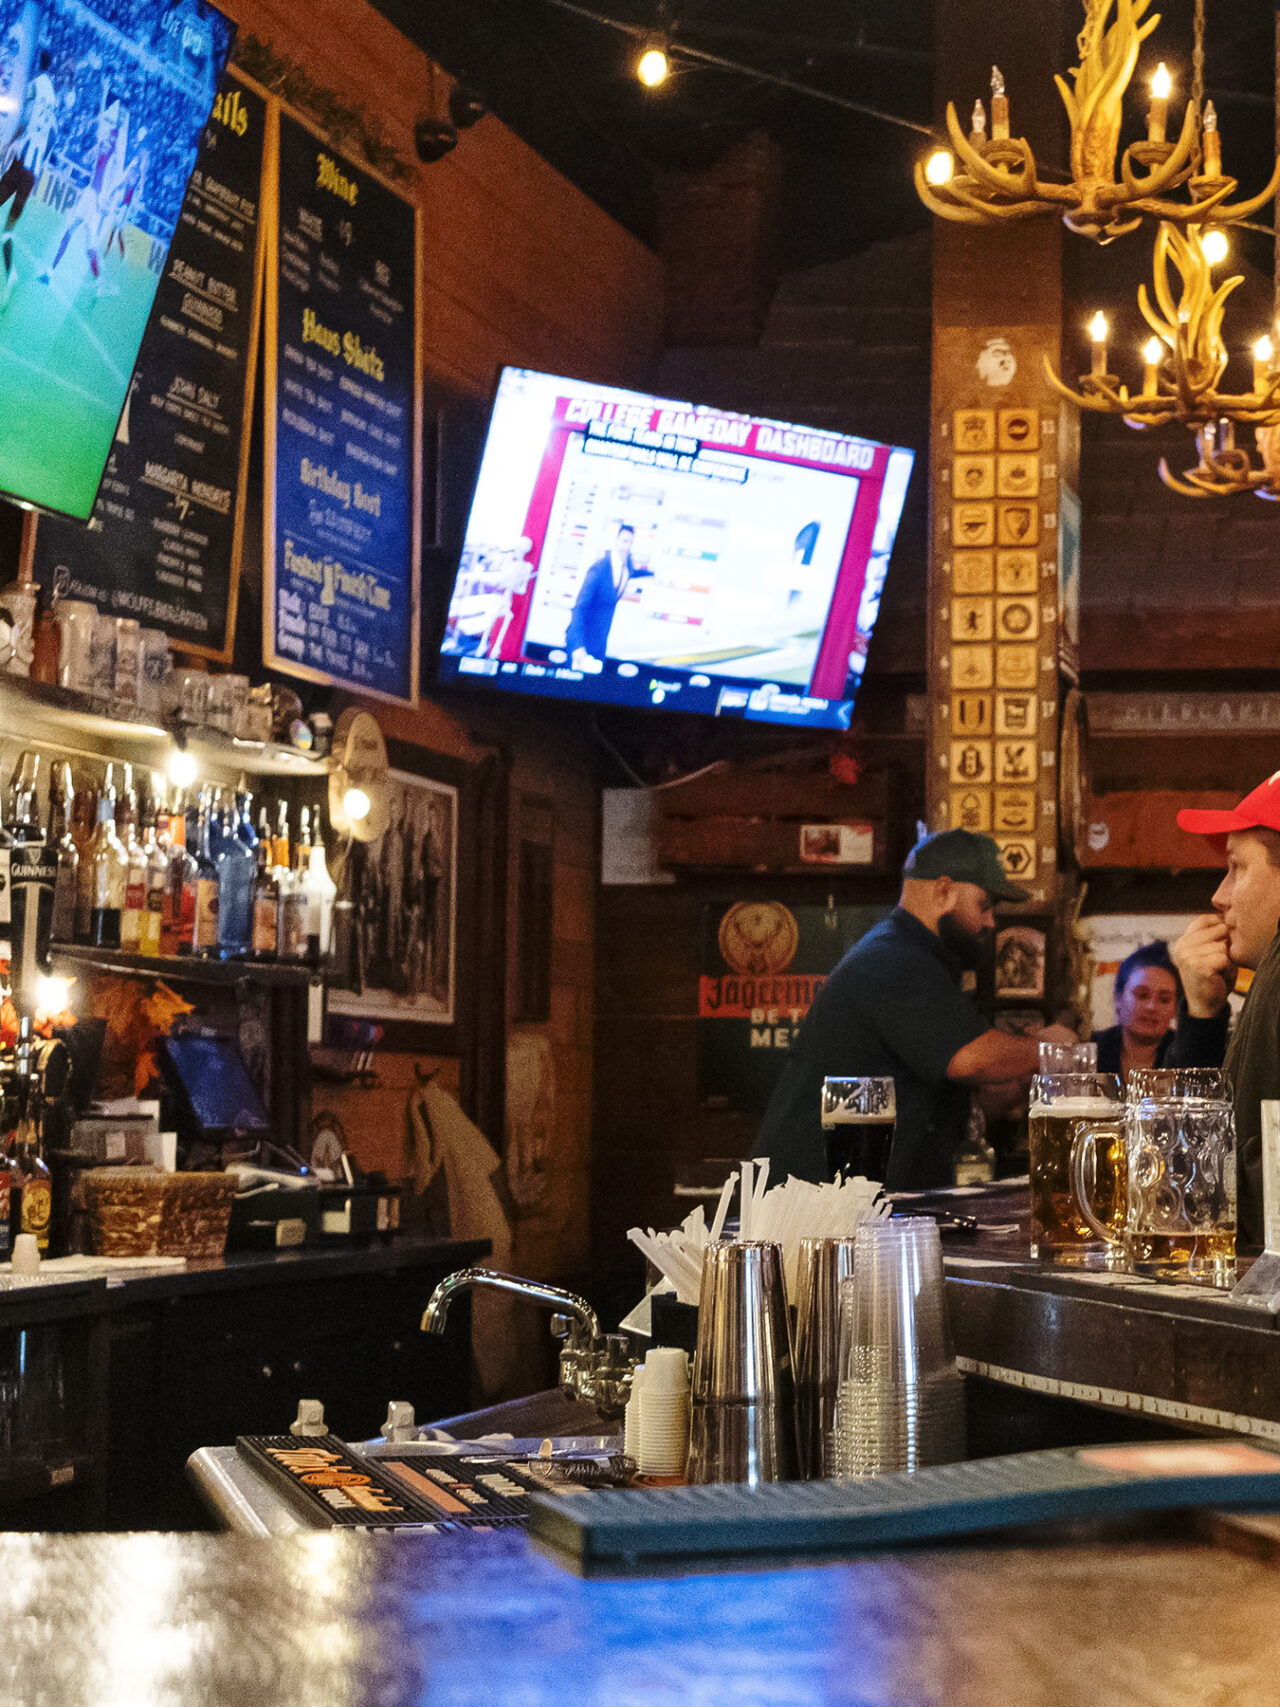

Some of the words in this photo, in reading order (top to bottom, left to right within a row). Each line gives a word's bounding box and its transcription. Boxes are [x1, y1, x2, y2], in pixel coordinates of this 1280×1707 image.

[564, 398, 655, 431] COLLEGE
[656, 409, 753, 447] GAMEDAY
[756, 424, 875, 471] DASHBOARD
[750, 1028, 800, 1048] ME
